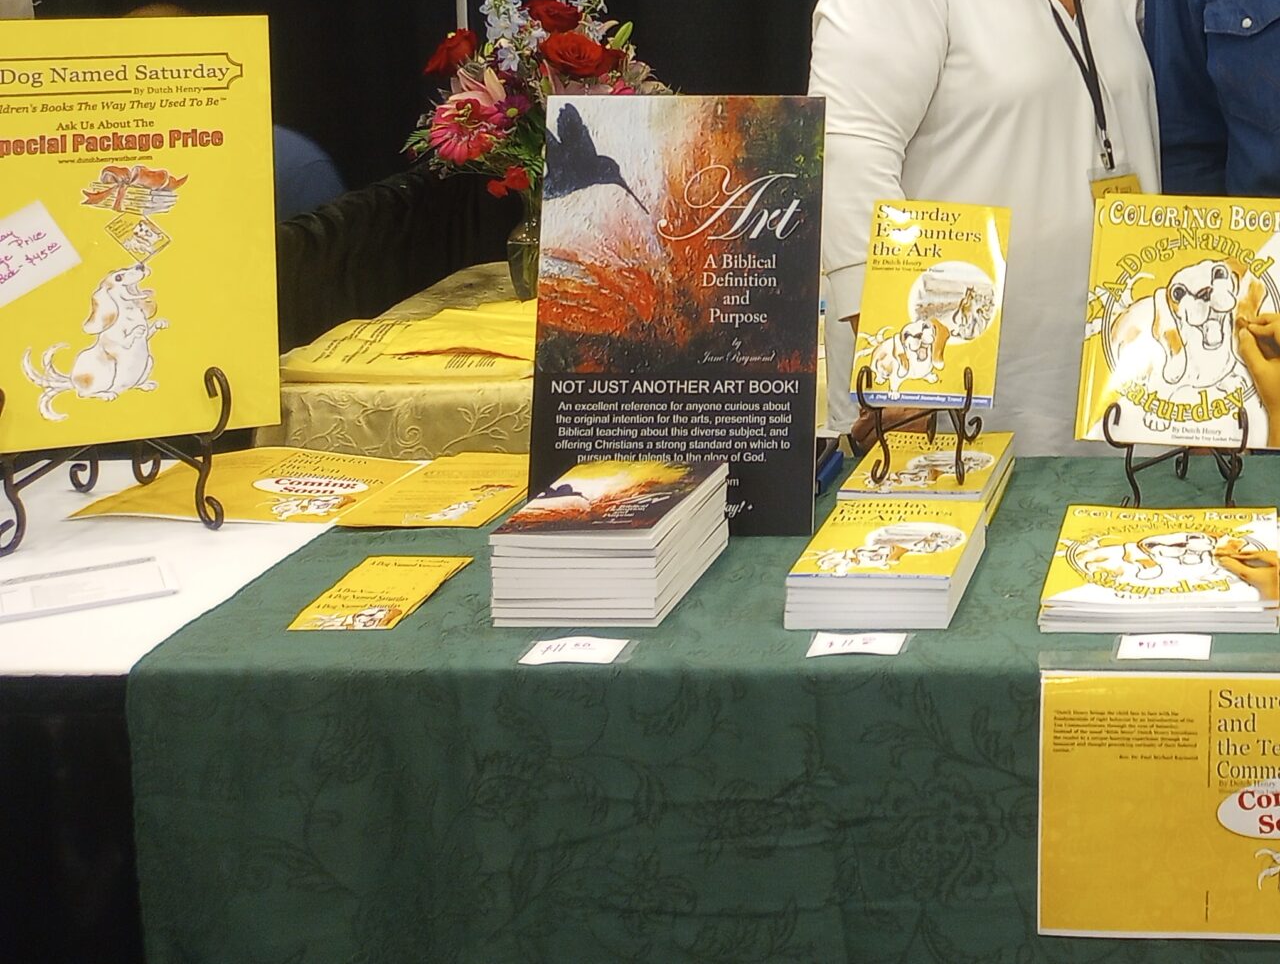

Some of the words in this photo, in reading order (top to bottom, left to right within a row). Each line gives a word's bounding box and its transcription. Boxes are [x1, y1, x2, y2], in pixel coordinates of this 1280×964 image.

[1, 68, 44, 88] Dog
[50, 65, 128, 83] Named
[135, 63, 230, 81] Saturday
[133, 87, 145, 95] By
[147, 86, 174, 94] Dutch
[176, 85, 204, 94] Henry
[40, 102, 74, 113] Books
[77, 101, 98, 111] The
[101, 100, 126, 112] Way
[129, 99, 156, 111] They
[160, 98, 186, 109] Used
[189, 97, 203, 108] To
[56, 121, 77, 131] Ask
[81, 121, 95, 130] Us
[97, 119, 131, 130] About
[133, 118, 155, 128] The
[72, 131, 164, 153] Package
[169, 129, 225, 149] Price
[657, 165, 802, 241] Art
[1109, 200, 1222, 230] COLORING
[873, 242, 900, 257] the
[907, 243, 943, 258] Ark
[704, 254, 718, 269] A
[722, 254, 777, 269] Biblical
[903, 259, 922, 267] Henry
[1102, 280, 1128, 302] A
[1116, 235, 1174, 279] Dog
[1176, 227, 1274, 280] Named
[702, 271, 777, 287] Definition
[723, 290, 750, 306] and
[709, 308, 768, 328] Purpose
[731, 338, 742, 350] by
[551, 380, 585, 394] NOT
[588, 380, 630, 394] JUST
[632, 380, 710, 394] ANOTHER
[713, 380, 746, 394] ART
[749, 380, 799, 394] BOOK!
[558, 402, 572, 411] An
[574, 402, 619, 411] excellent
[621, 402, 667, 411] reference
[670, 402, 683, 411] for
[686, 403, 722, 413] anyone
[724, 402, 760, 411] curious
[762, 402, 790, 411] about
[556, 414, 571, 424] the
[574, 414, 610, 425] original
[612, 414, 654, 424] intention
[657, 414, 670, 424] for
[672, 414, 688, 424] the
[690, 414, 712, 425] arts,
[715, 414, 766, 425] presenting
[769, 414, 791, 424] solid
[558, 427, 594, 436] Biblical
[596, 427, 638, 438] teaching
[640, 427, 668, 436] about
[671, 427, 688, 436] this
[690, 427, 726, 436] diverse
[729, 427, 766, 438] subject,
[769, 427, 788, 436] and
[555, 439, 592, 451] offering
[594, 439, 644, 449] Christians
[646, 441, 653, 449] a
[655, 440, 686, 451] strong
[689, 439, 732, 449] standard
[734, 441, 747, 449] on
[749, 439, 778, 449] which
[781, 439, 790, 449] to
[614, 452, 636, 460] their
[673, 452, 683, 461] to
[686, 452, 701, 461] the
[731, 452, 741, 461] of
[743, 452, 767, 462] God.
[275, 478, 357, 489] Coming
[280, 486, 335, 494] Soon
[1217, 713, 1257, 733] and
[1217, 738, 1251, 756] the
